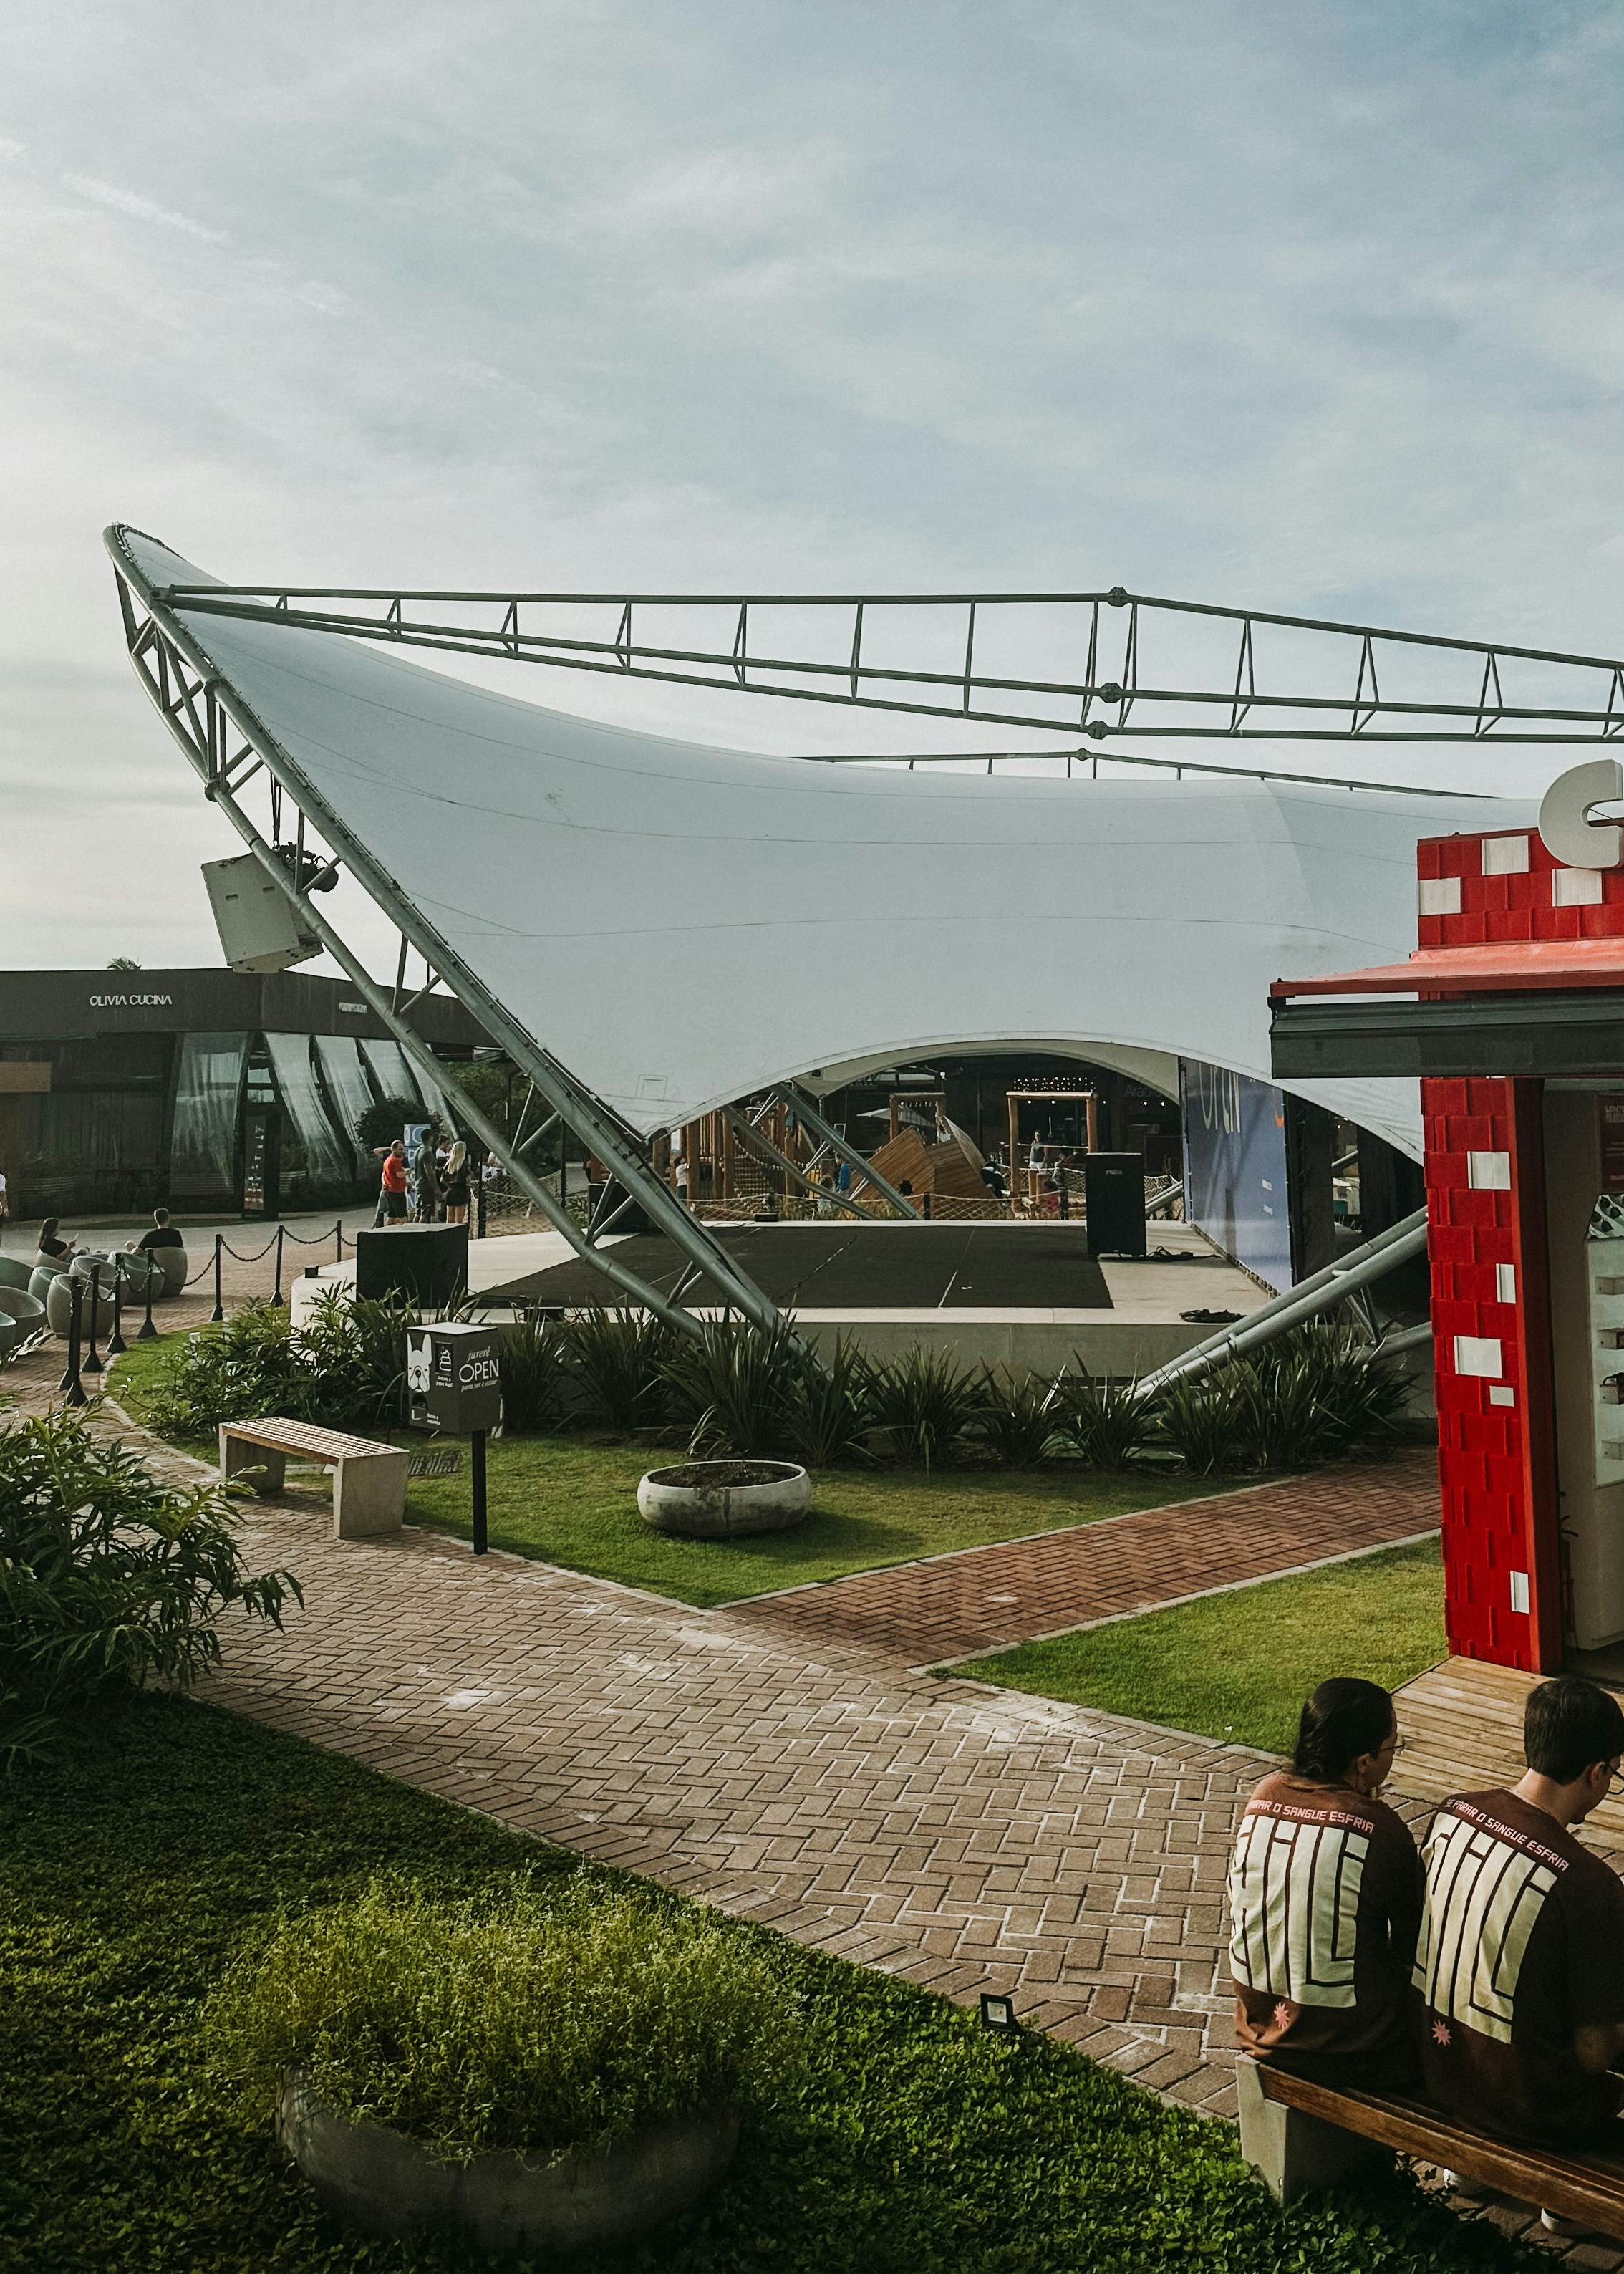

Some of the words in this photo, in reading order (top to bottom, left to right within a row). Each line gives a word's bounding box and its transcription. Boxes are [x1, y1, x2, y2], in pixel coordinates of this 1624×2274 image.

[90, 995, 127, 1006] OLIVIA
[130, 994, 173, 1005] CUCINA
[459, 1358, 499, 1383] OPEN
[1273, 1803, 1282, 1813] O
[1282, 1805, 1328, 1821] SANGUE
[1328, 1811, 1375, 1834] ESFRIA
[1451, 1800, 1479, 1818] PARAR
[1476, 1812, 1487, 1823] O
[1484, 1818, 1528, 1845] SANGUE
[1526, 1839, 1570, 1871] ESFRIA
